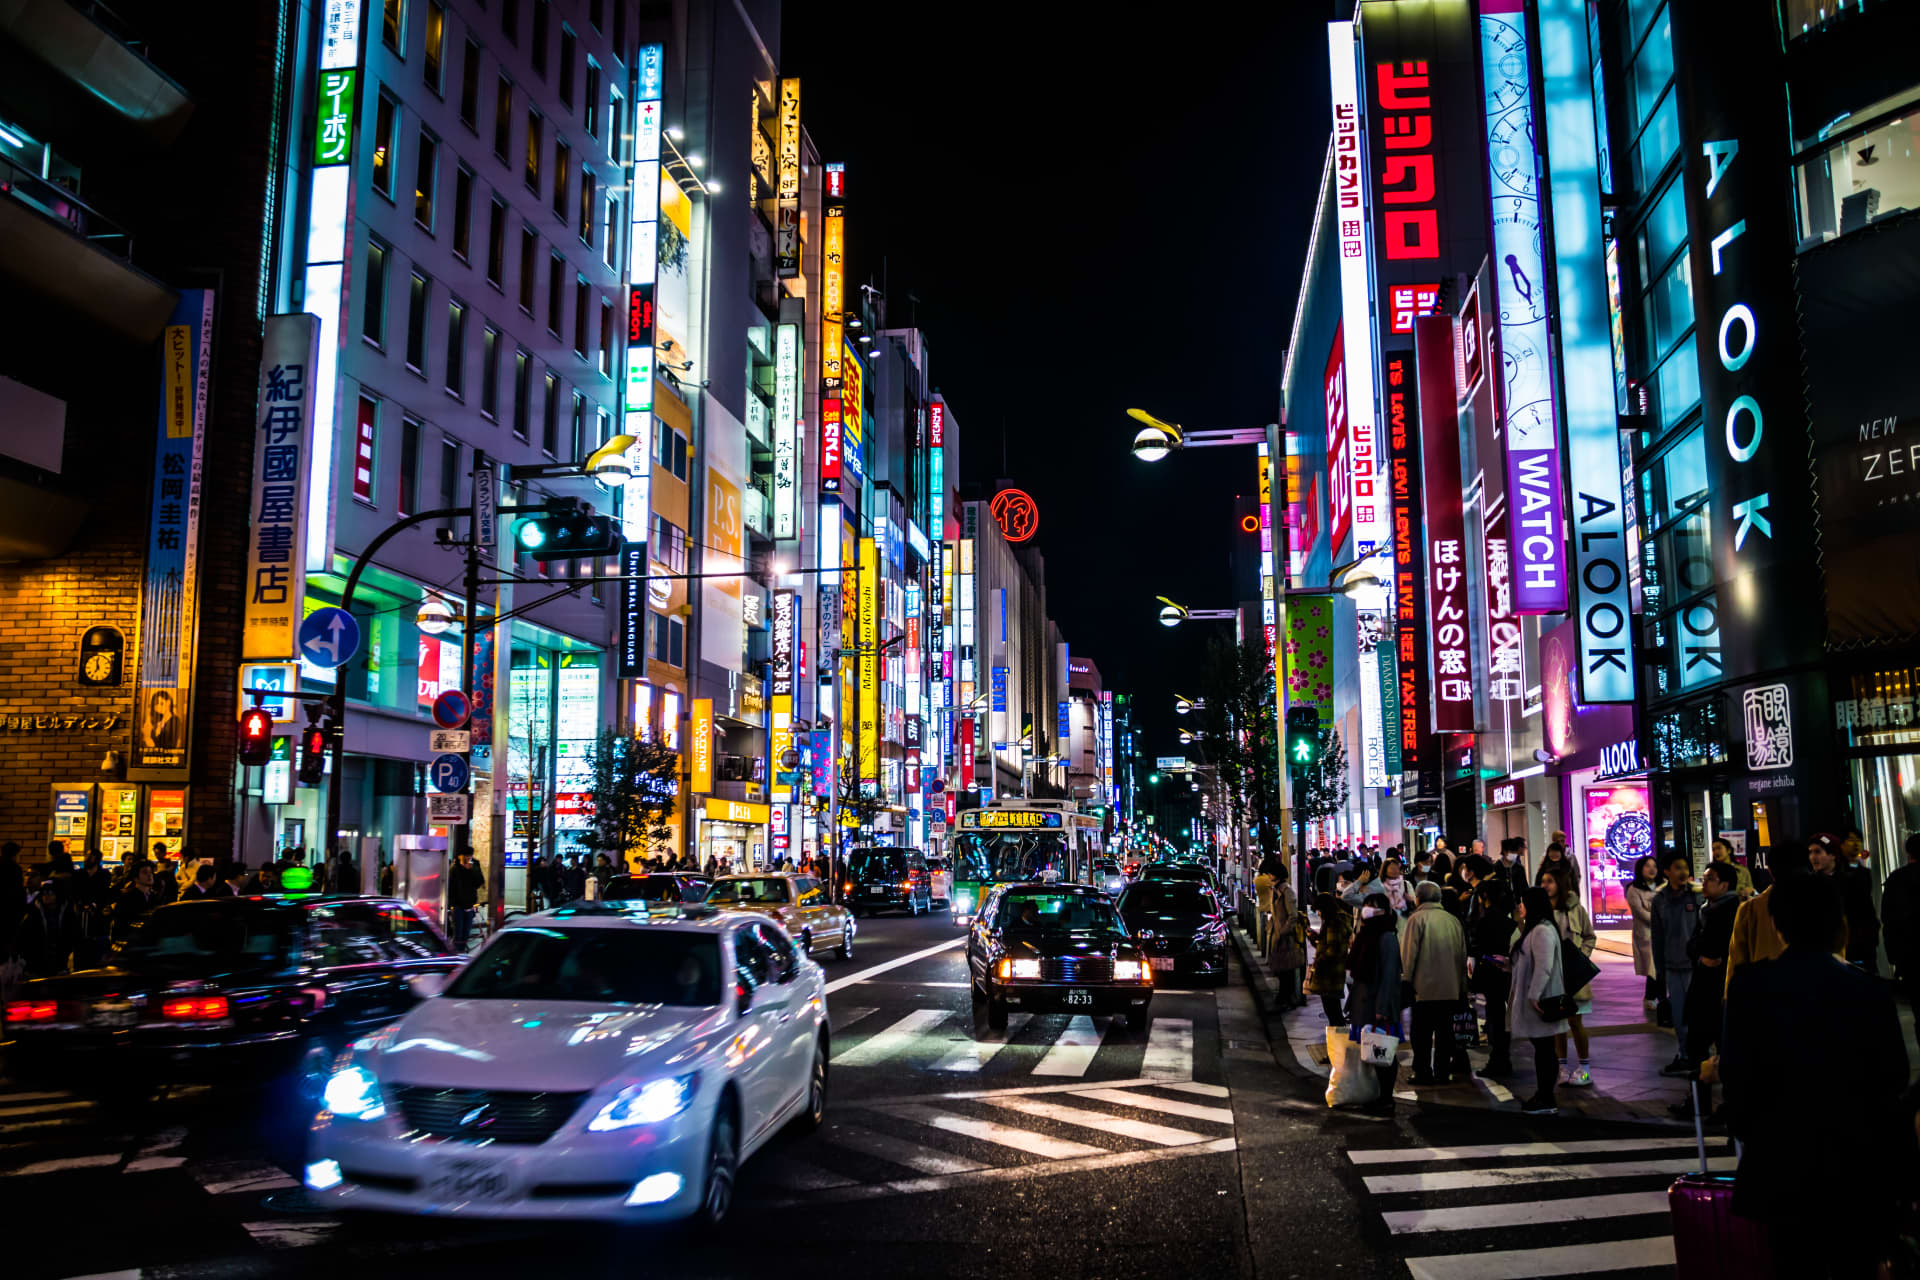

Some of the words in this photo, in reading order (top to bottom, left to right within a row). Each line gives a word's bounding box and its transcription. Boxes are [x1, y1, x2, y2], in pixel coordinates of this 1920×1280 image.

[782, 179, 797, 189] 8F
[828, 208, 842, 217] 9F
[782, 258, 795, 267] 7F
[631, 291, 642, 341] union
[1702, 138, 1772, 553] ALOOK
[826, 378, 840, 387] 9F
[824, 422, 840, 466] ガスト
[1858, 415, 1898, 442] NEW
[157, 452, 185, 550] 松岡圭祐
[252, 364, 303, 605] 紀伊國屋書店
[478, 471, 492, 544] スクランブル交差点
[1518, 453, 1556, 588] WATCH
[1398, 572, 1414, 620] LIVE
[1578, 491, 1627, 674] ALOOK
[822, 593, 832, 667] みずのクリニック
[1433, 539, 1466, 702] ほけんの窓口
[774, 681, 791, 693] 2F
[1381, 655, 1394, 708] DIAMOND
[1401, 669, 1416, 707] TAX
[699, 718, 709, 772] L'OCCITANE
[1384, 710, 1398, 764] SHIRAISHI
[1402, 707, 1418, 750] FREE
[438, 763, 453, 788] P
[1367, 737, 1380, 786] ROLEX
[1600, 740, 1639, 777] ALOOK
[448, 776, 460, 788] 40
[1772, 775, 1796, 789] ichiba
[1068, 995, 1092, 1005] 82-33
